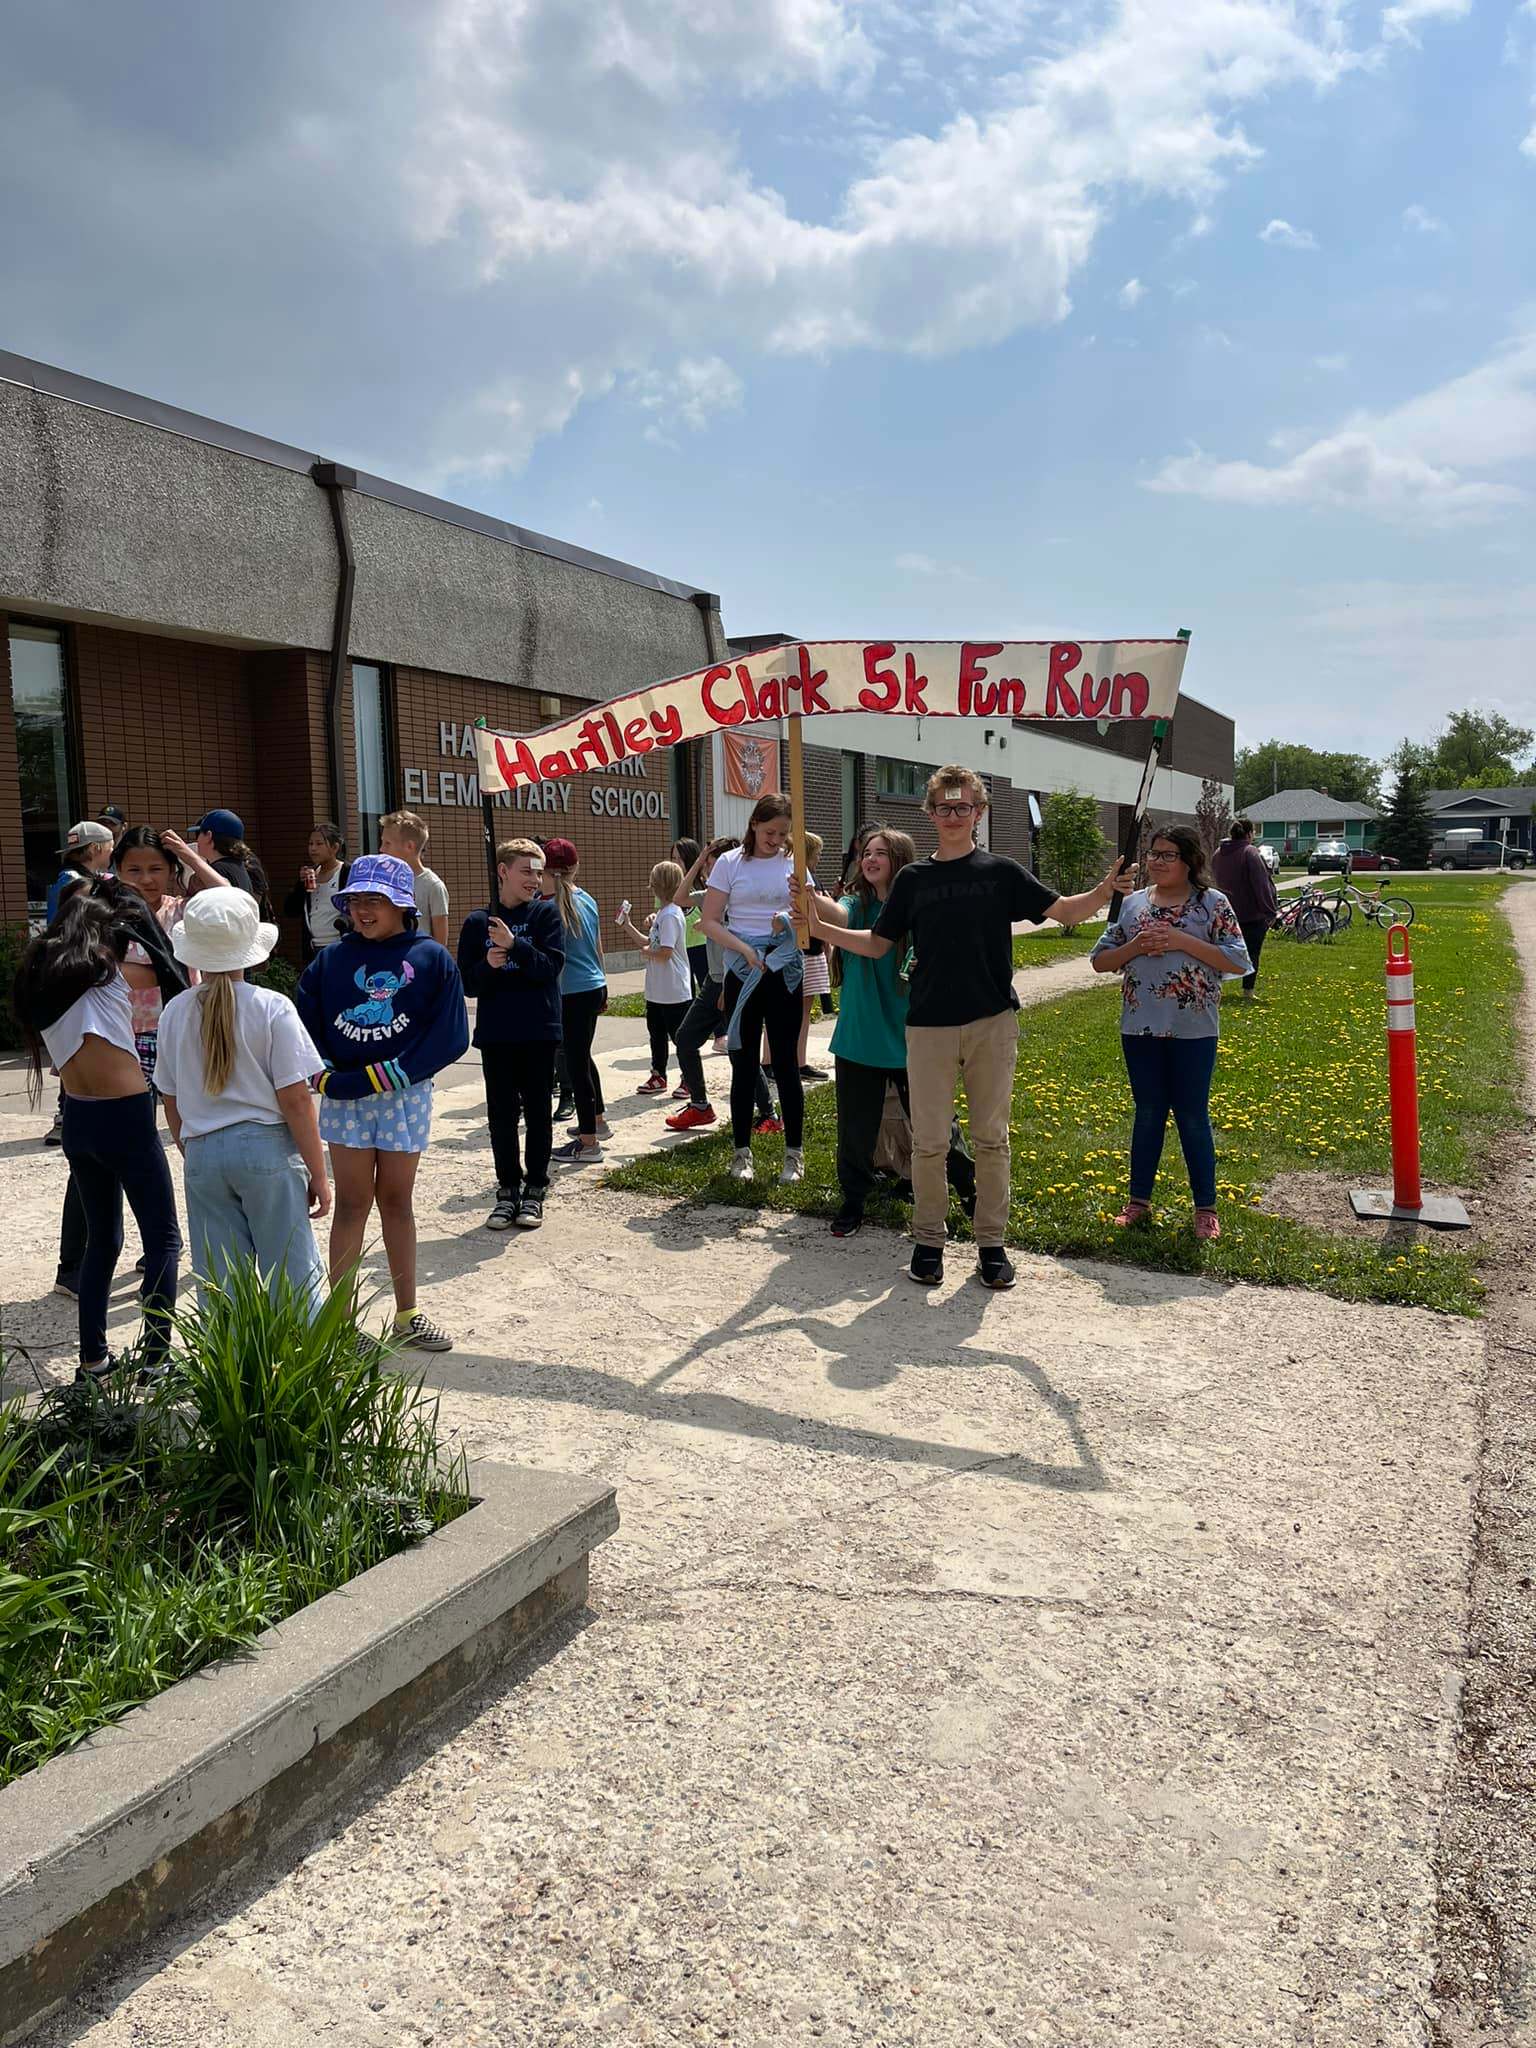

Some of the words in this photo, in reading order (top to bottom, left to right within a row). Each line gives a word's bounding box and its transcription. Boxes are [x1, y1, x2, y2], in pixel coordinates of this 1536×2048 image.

[494, 704, 683, 789] Hartley
[701, 645, 830, 726] Clark
[858, 642, 929, 714] 5k
[958, 642, 1027, 717] Fun
[1045, 642, 1150, 718] Run
[404, 767, 572, 813] ELEMNTARY
[591, 785, 671, 819] SCHOOL
[333, 1012, 411, 1043] WHATEVER
